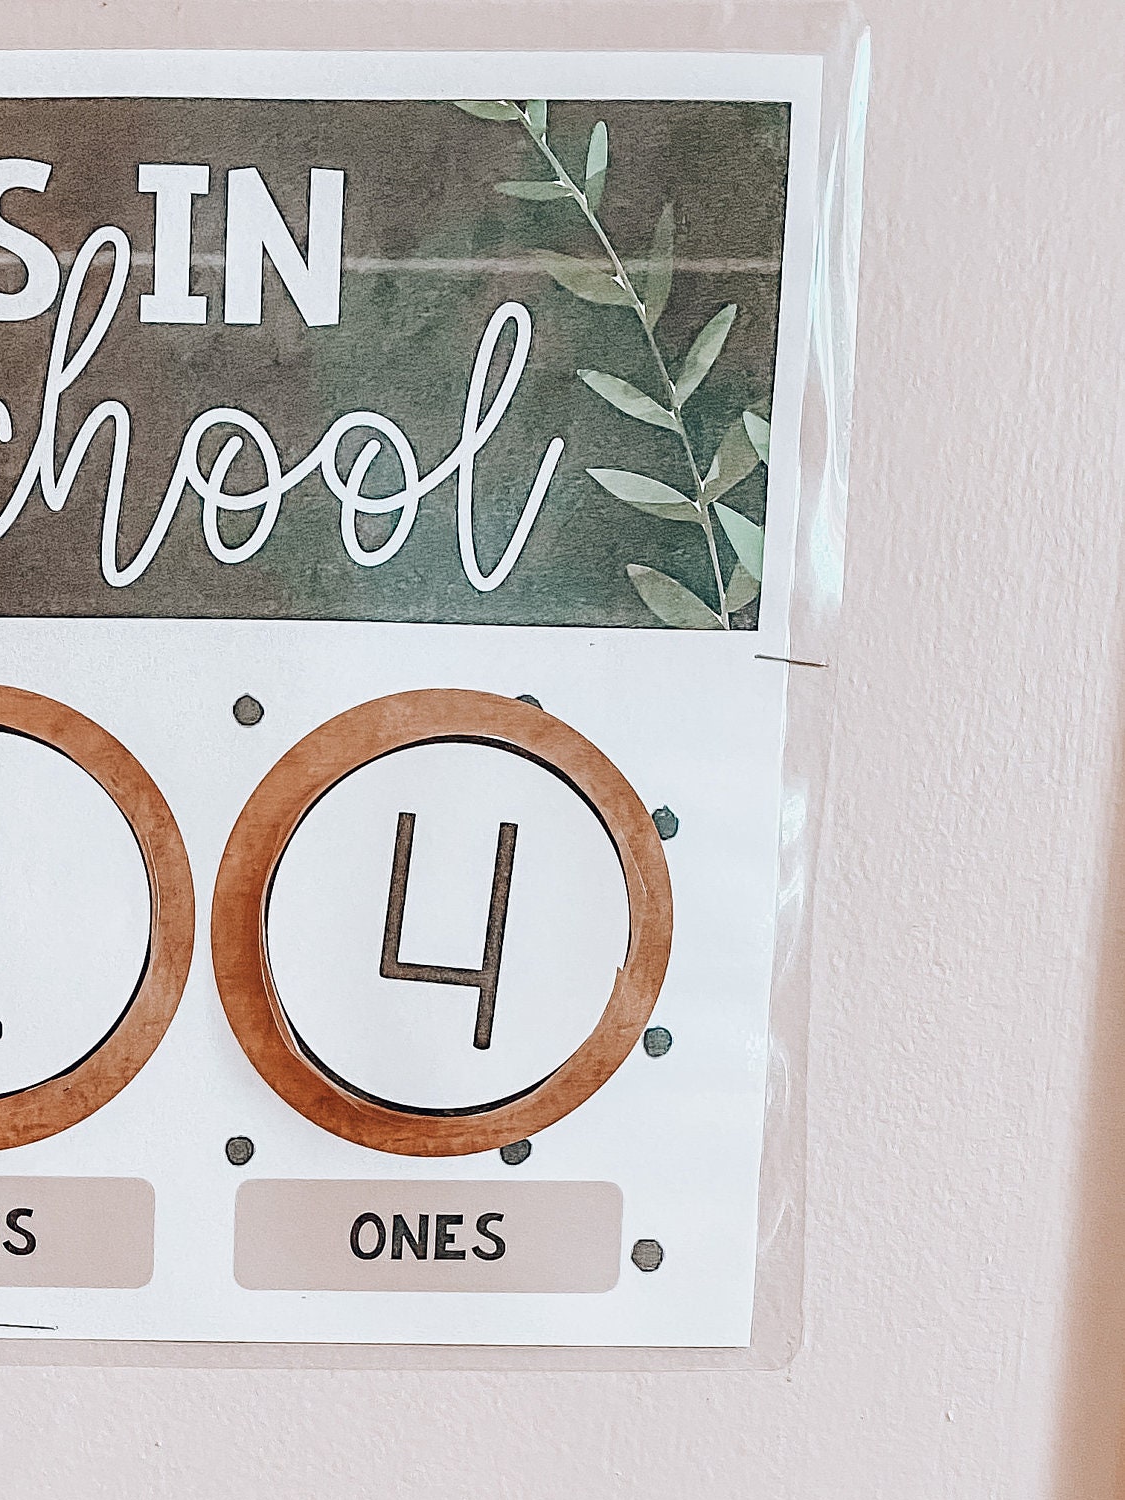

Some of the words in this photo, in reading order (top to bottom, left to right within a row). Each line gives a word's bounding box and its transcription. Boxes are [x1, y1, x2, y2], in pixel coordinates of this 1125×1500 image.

[136, 162, 346, 328] IN
[378, 811, 518, 1051] 4
[348, 1211, 508, 1263] ONES
